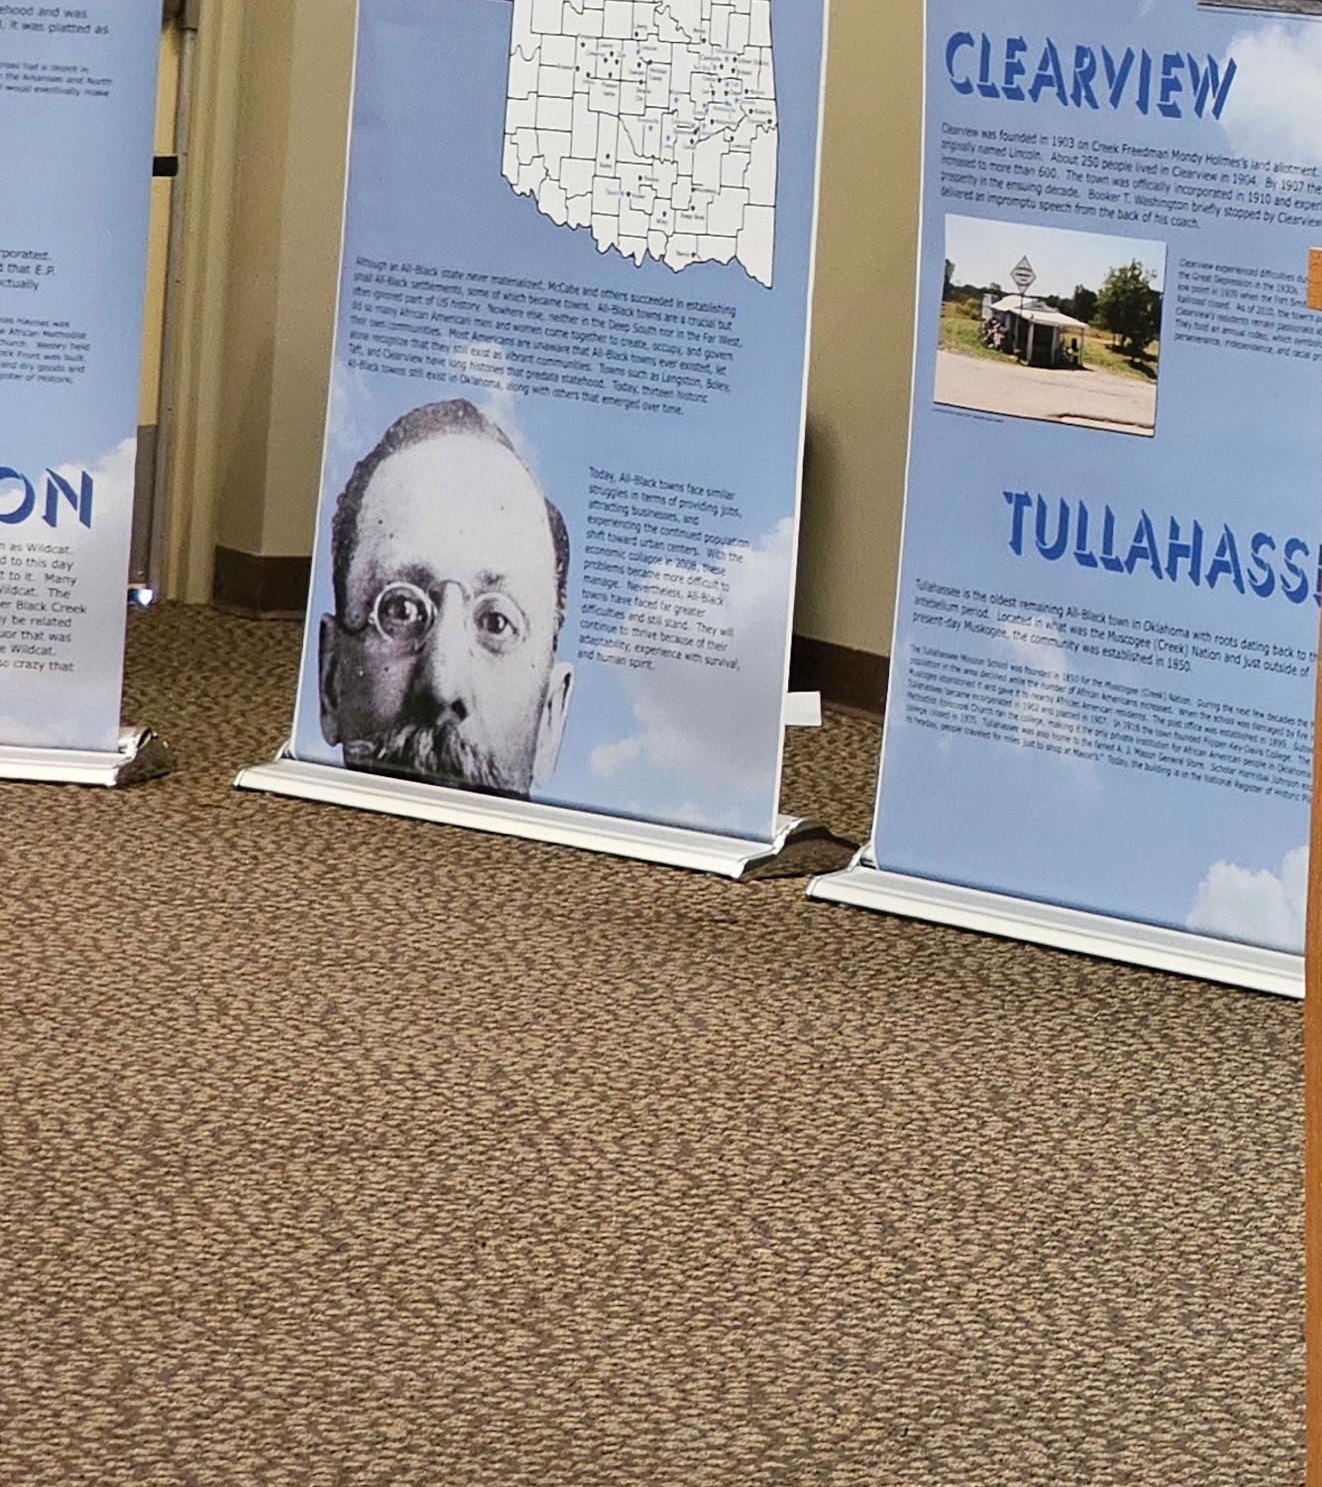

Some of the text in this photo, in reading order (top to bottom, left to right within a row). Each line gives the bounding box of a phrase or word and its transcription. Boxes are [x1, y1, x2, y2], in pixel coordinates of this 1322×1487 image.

[946, 32, 1236, 120] CLEARVIEW
[9, 555, 73, 572] to this day
[15, 600, 86, 613] Black Creek
[11, 614, 72, 627] be related
